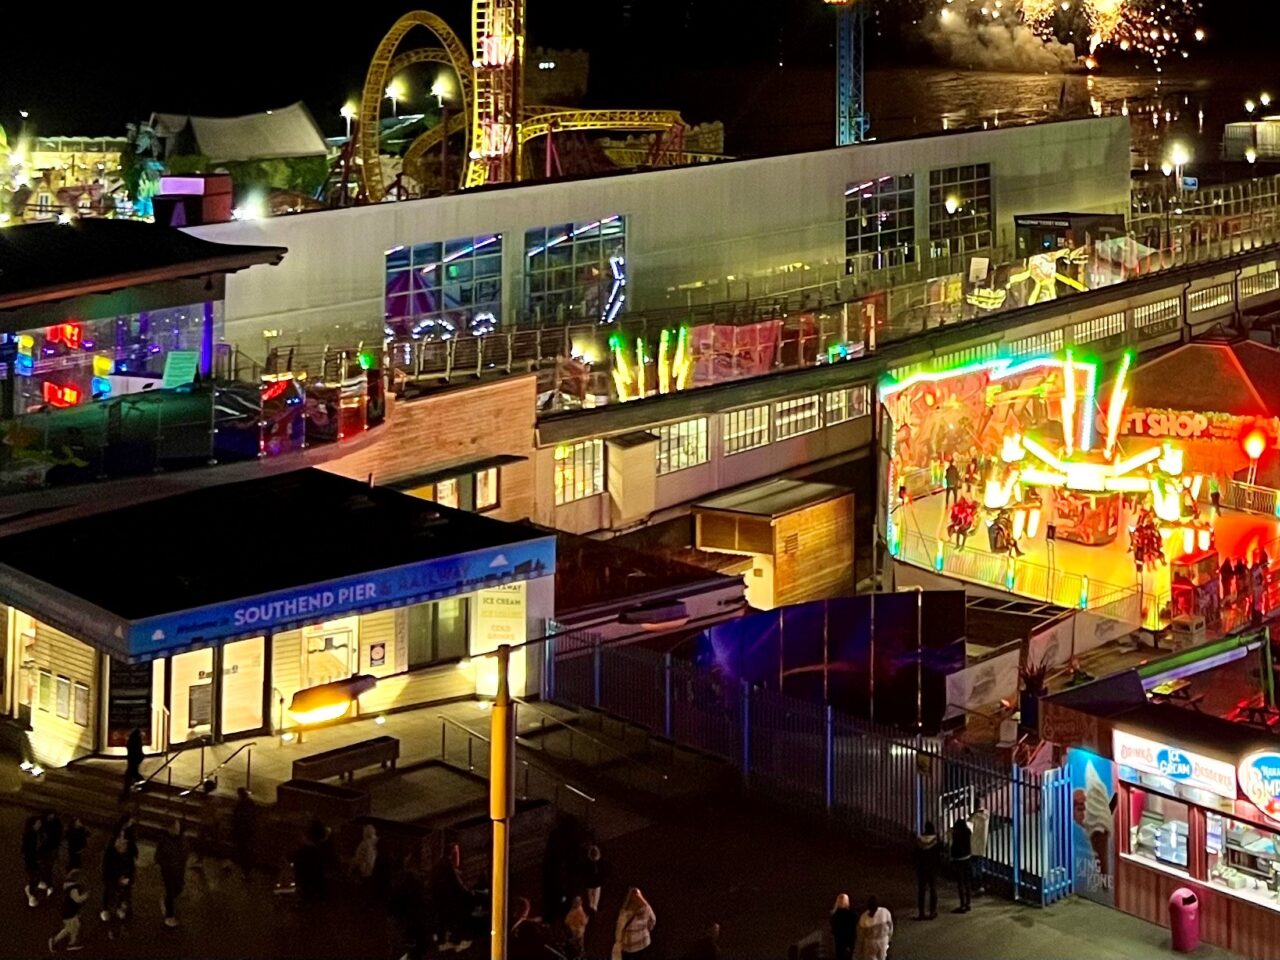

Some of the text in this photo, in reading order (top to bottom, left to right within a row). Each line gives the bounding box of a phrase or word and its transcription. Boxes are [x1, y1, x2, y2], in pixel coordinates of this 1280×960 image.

[1147, 413, 1208, 437] SHOP
[234, 591, 334, 627] SOUTHEND
[338, 582, 377, 605] PIER
[482, 597, 521, 606] ICE CREAM
[1121, 745, 1153, 762] DRINKS
[1168, 749, 1181, 763] ICE
[1076, 857, 1101, 874] KING
